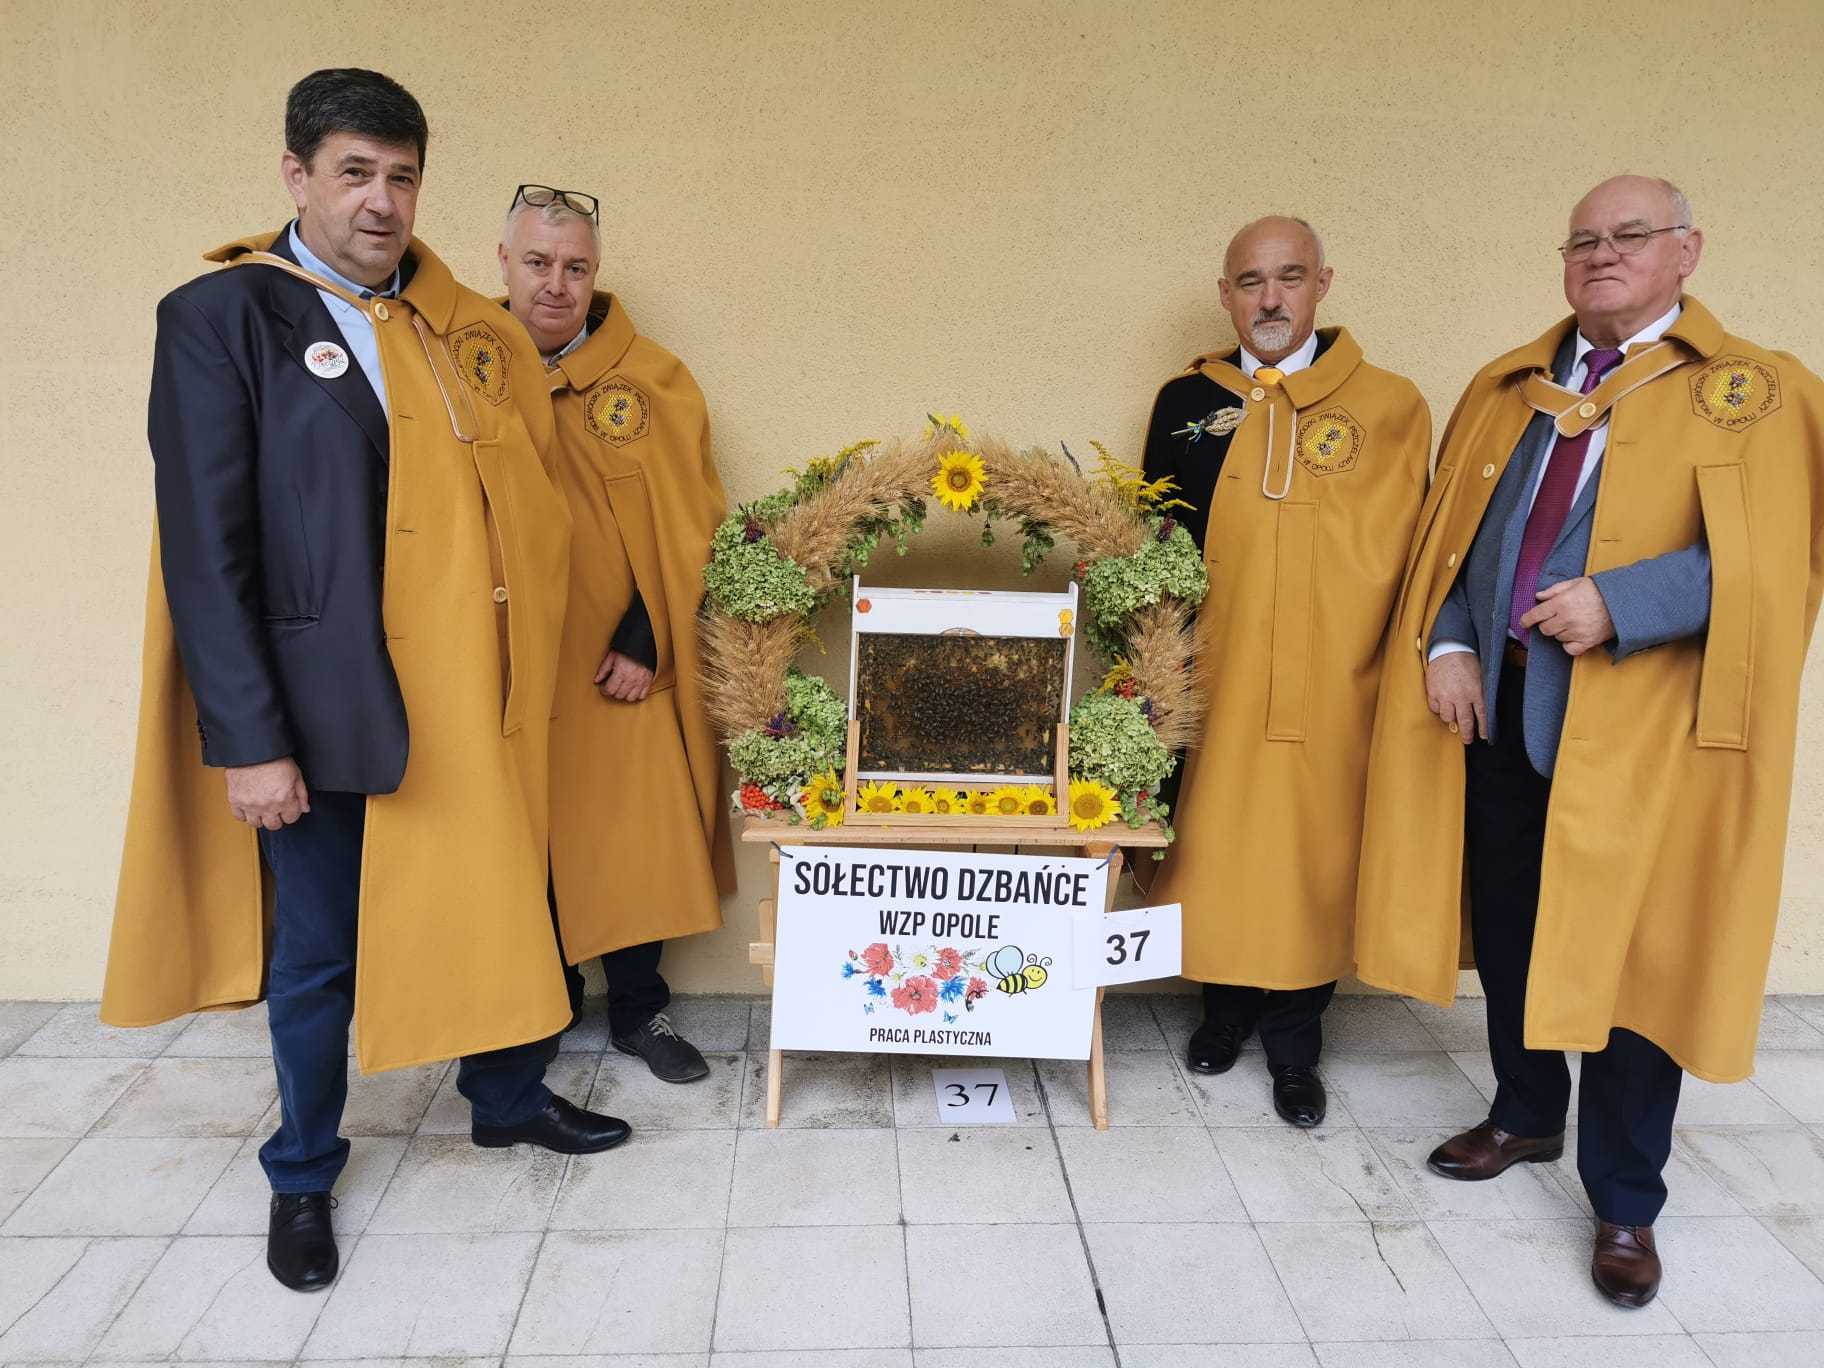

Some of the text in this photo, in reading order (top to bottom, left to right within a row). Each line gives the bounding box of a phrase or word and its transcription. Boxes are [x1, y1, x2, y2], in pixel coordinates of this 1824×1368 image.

[957, 865, 1089, 906] DZBAŃCE
[879, 910, 1001, 940] WZP OPOLE
[1106, 930, 1151, 966] 37
[869, 1027, 992, 1047] PRACA PLASTYCZNA
[944, 1083, 1000, 1107] 37
